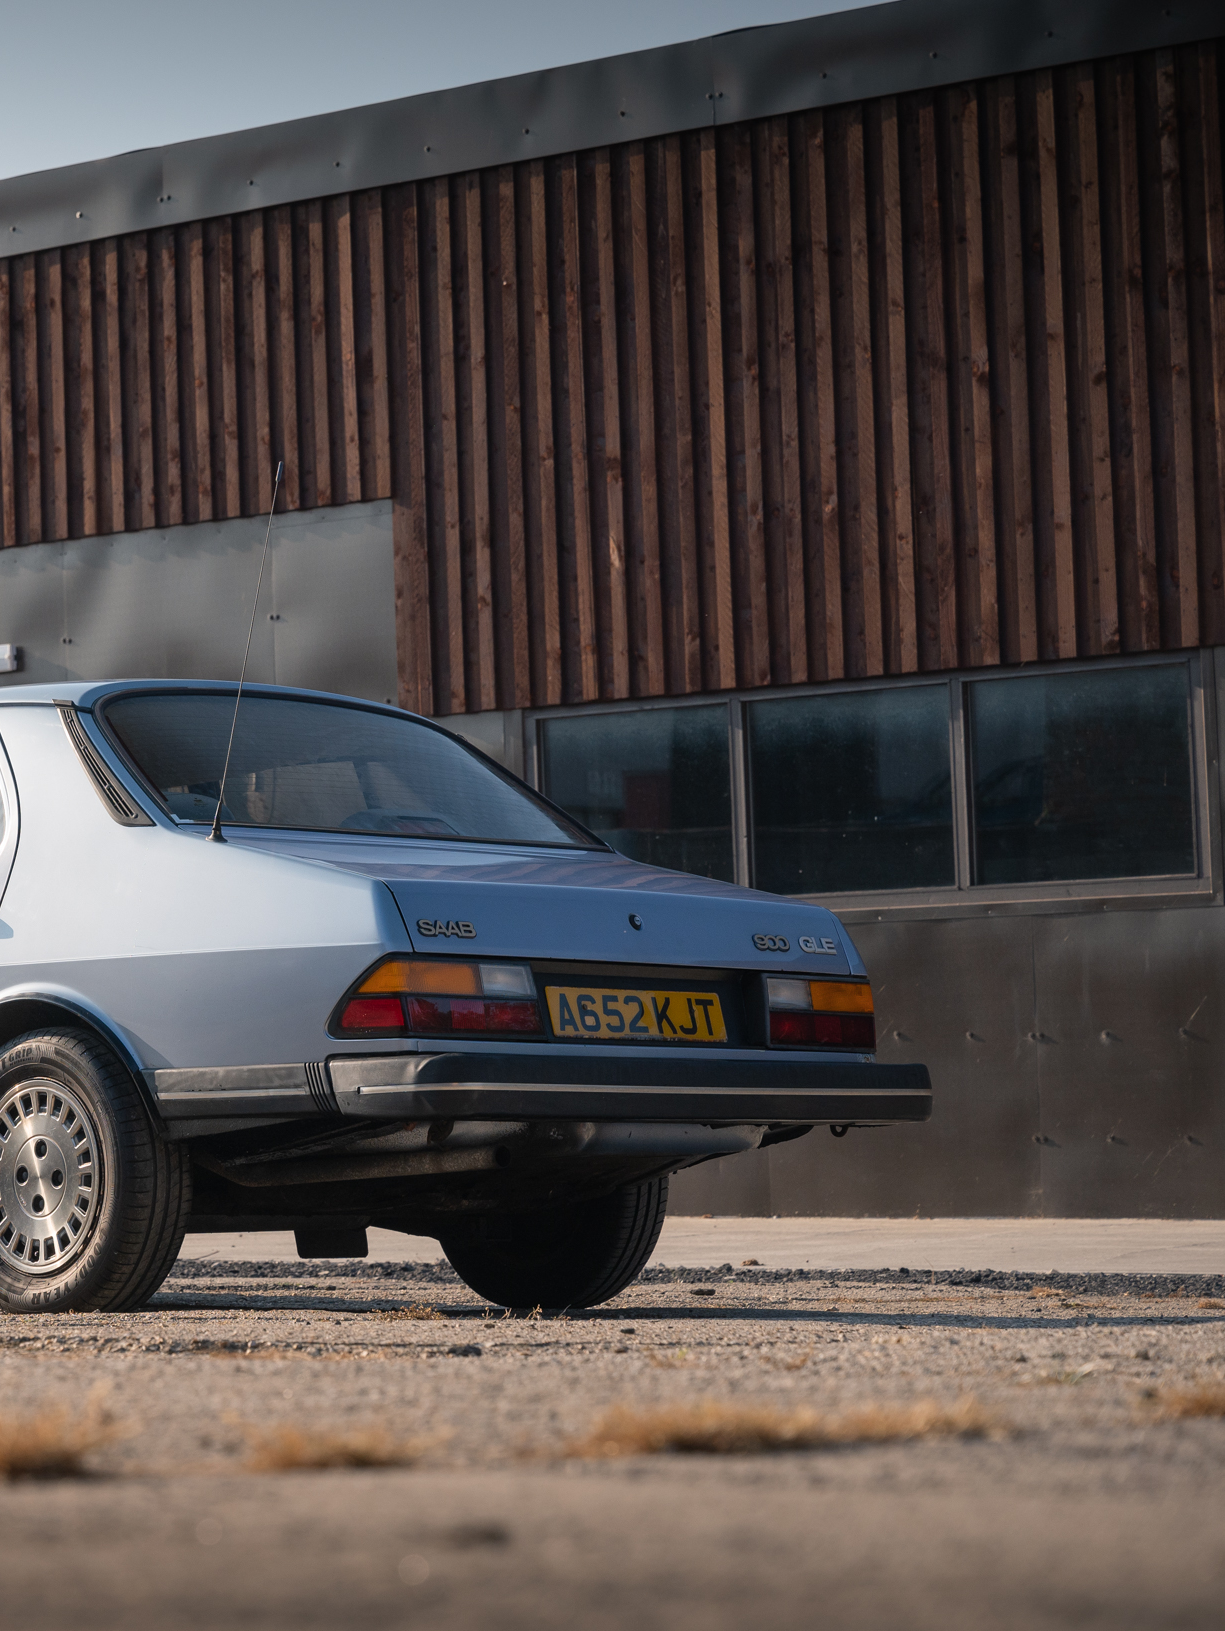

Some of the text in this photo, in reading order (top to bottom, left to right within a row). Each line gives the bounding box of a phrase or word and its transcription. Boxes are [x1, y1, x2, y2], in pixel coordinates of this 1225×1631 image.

[416, 919, 477, 939] SAAB
[752, 934, 837, 955] 900 GLE
